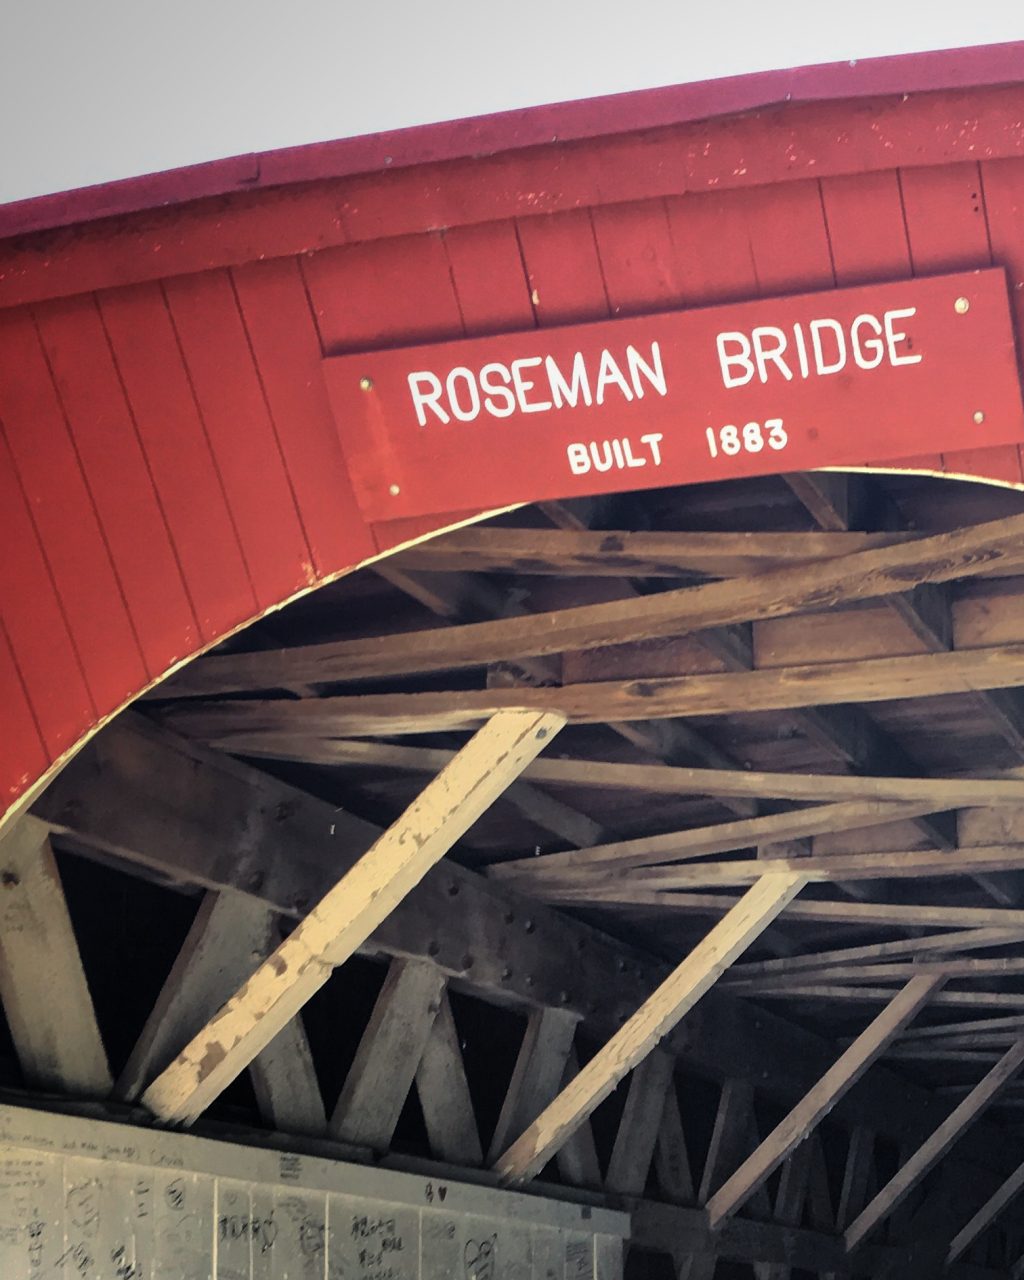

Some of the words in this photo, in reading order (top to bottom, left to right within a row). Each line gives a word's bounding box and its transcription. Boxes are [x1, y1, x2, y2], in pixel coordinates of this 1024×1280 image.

[407, 340, 668, 427] ROSEMAN
[716, 306, 923, 389] BRIDGE
[566, 432, 664, 475] BUILT
[705, 417, 788, 458] 1883
